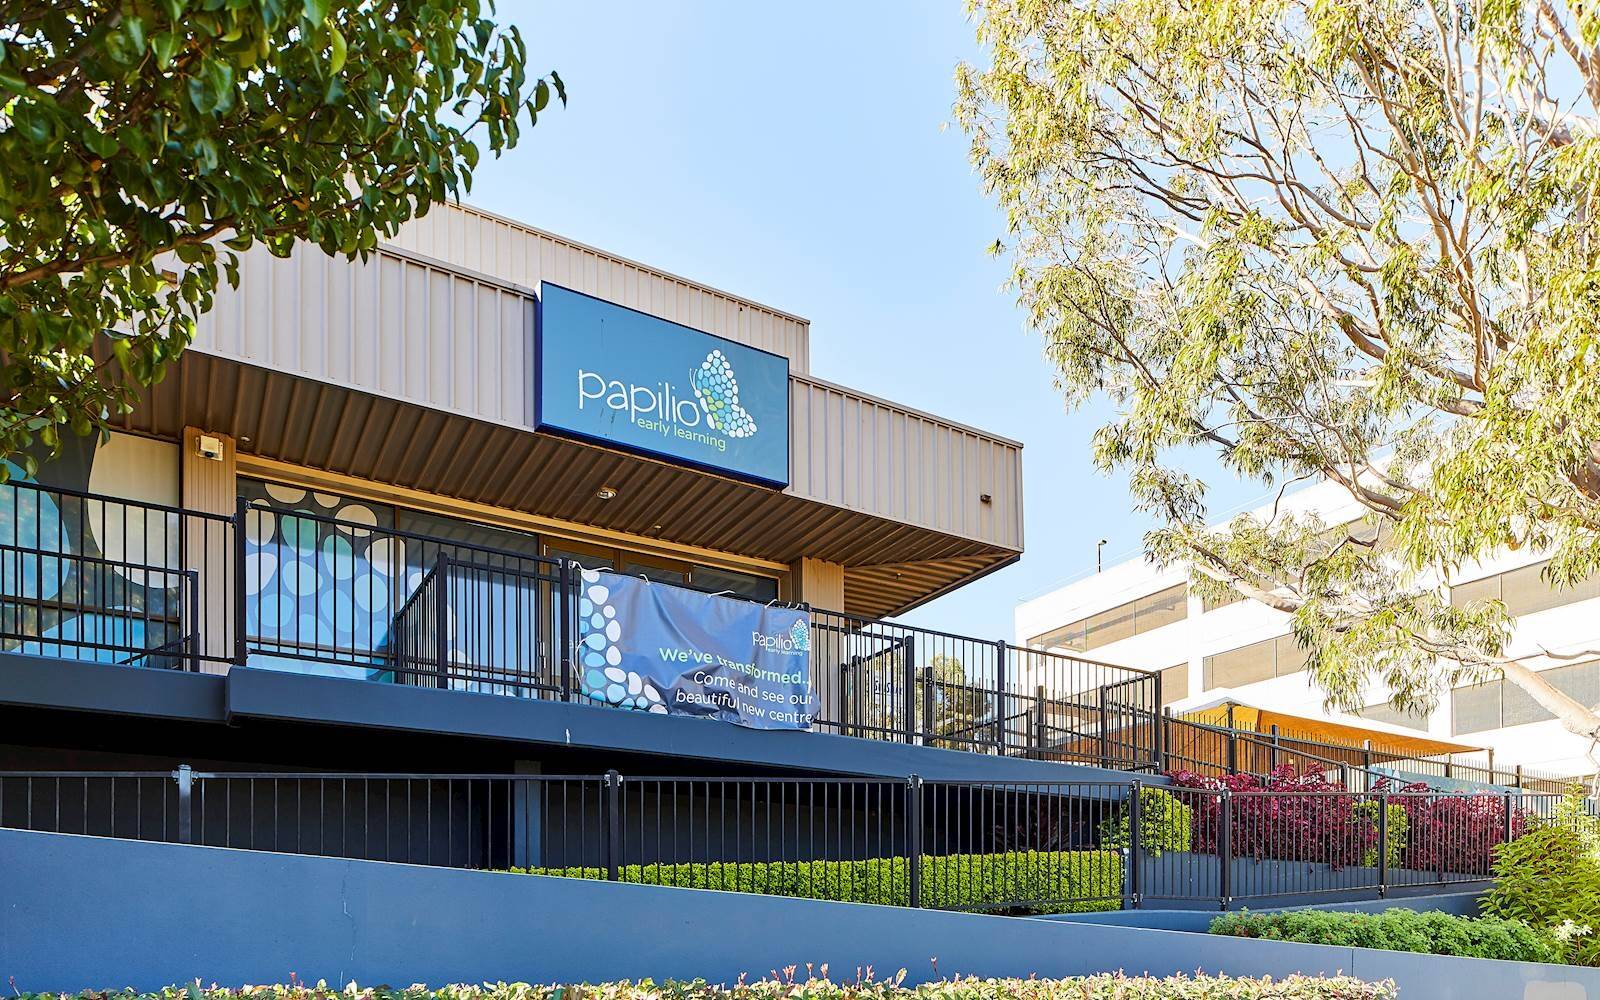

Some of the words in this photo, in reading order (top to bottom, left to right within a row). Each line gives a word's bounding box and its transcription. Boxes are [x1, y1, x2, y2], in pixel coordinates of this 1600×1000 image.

[578, 369, 700, 427] papilio
[637, 416, 670, 437] early
[674, 425, 726, 451] learning
[659, 647, 713, 664] We've
[693, 671, 736, 689] Come
[737, 682, 759, 699] and
[761, 690, 785, 704] see
[789, 694, 813, 705] our
[675, 688, 740, 710] beautiful
[742, 702, 765, 718] new
[769, 709, 813, 724] centre
